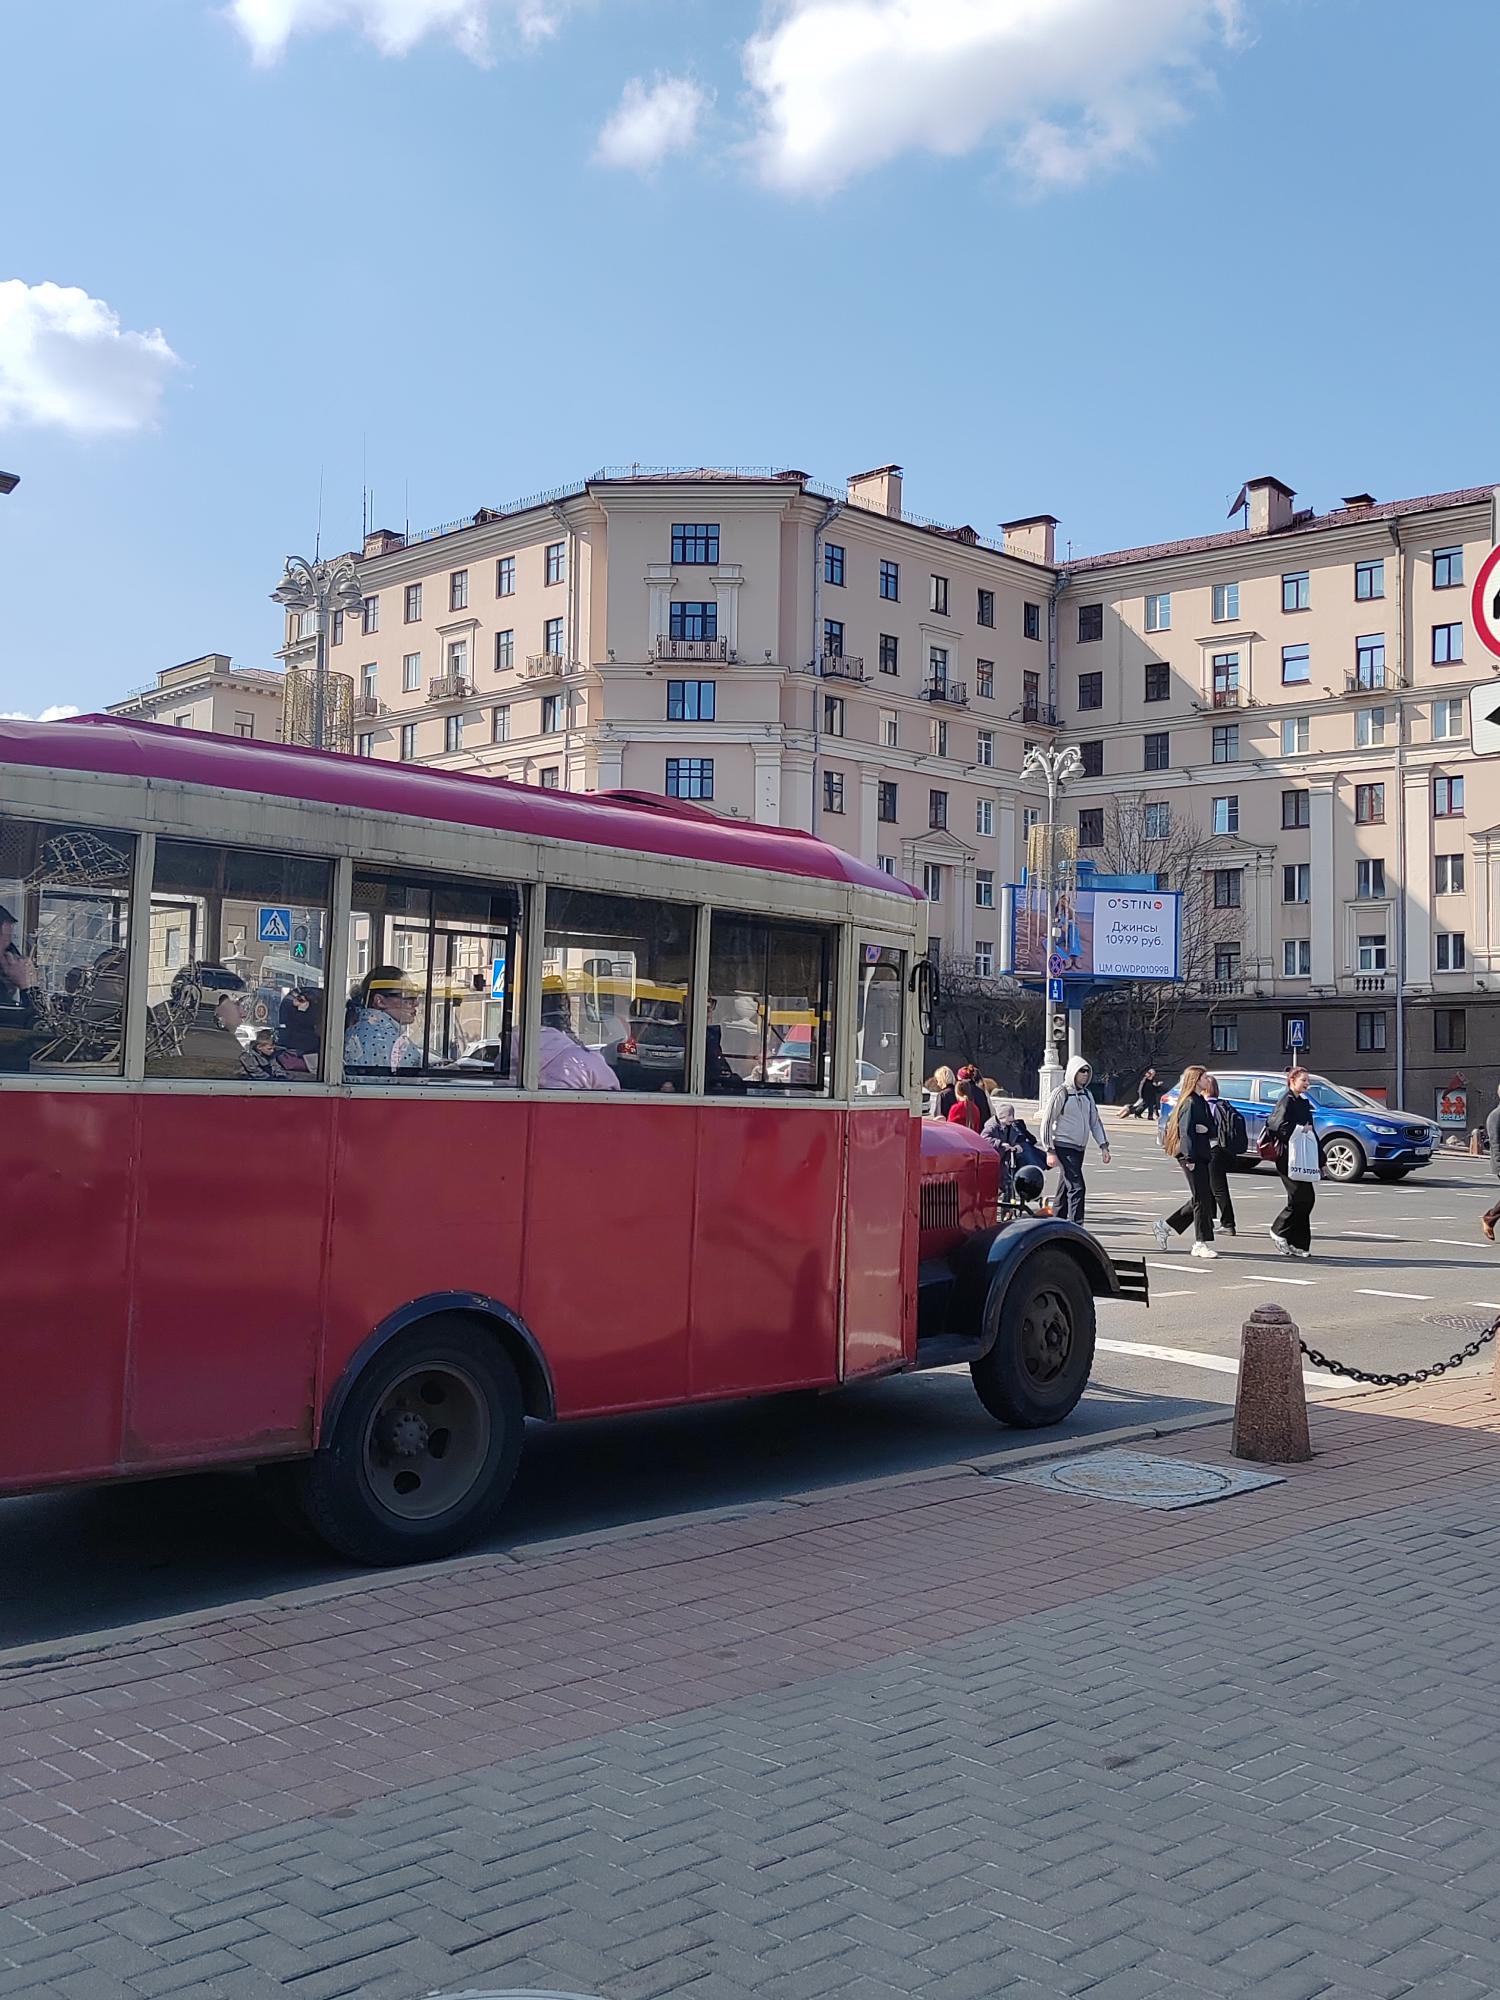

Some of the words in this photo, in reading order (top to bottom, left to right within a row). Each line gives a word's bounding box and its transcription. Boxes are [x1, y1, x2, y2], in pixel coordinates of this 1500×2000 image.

[1112, 922, 1158, 933] Джинсы
[1106, 934, 1139, 945] 10999
[1141, 936, 1164, 947] руб.
[1099, 963, 1113, 973] ЦМ
